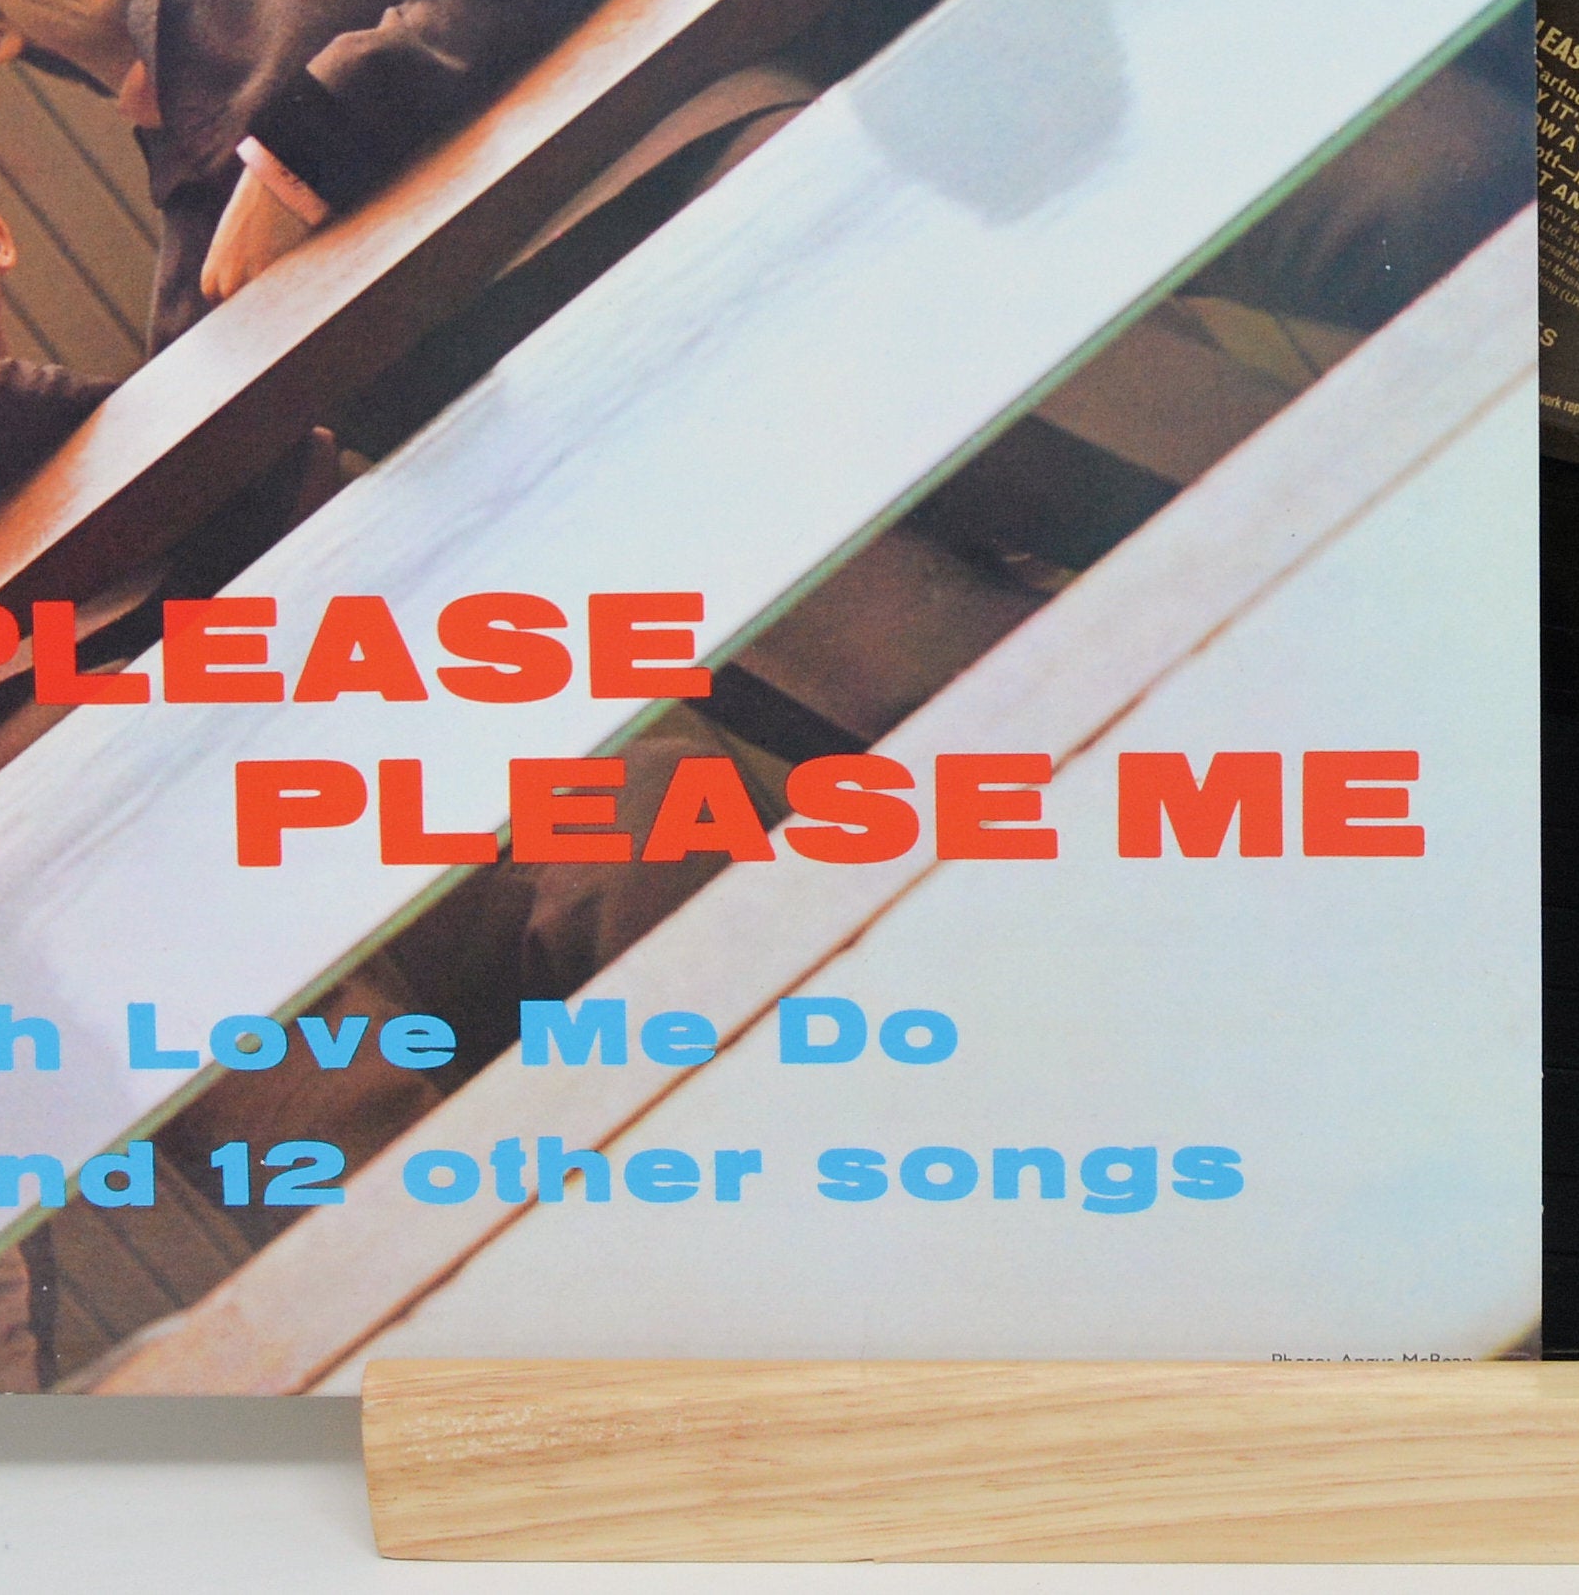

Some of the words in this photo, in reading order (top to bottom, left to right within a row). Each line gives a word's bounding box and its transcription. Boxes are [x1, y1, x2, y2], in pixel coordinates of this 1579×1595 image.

[1559, 135, 1575, 152] A
[235, 754, 1058, 868] PLEASE
[1118, 751, 1424, 859] ME
[128, 1004, 457, 1071] Love
[520, 1000, 718, 1066] Me
[779, 997, 958, 1065] Do
[211, 1141, 346, 1207] 12
[404, 1136, 762, 1205] other
[817, 1146, 1244, 1214] songs
